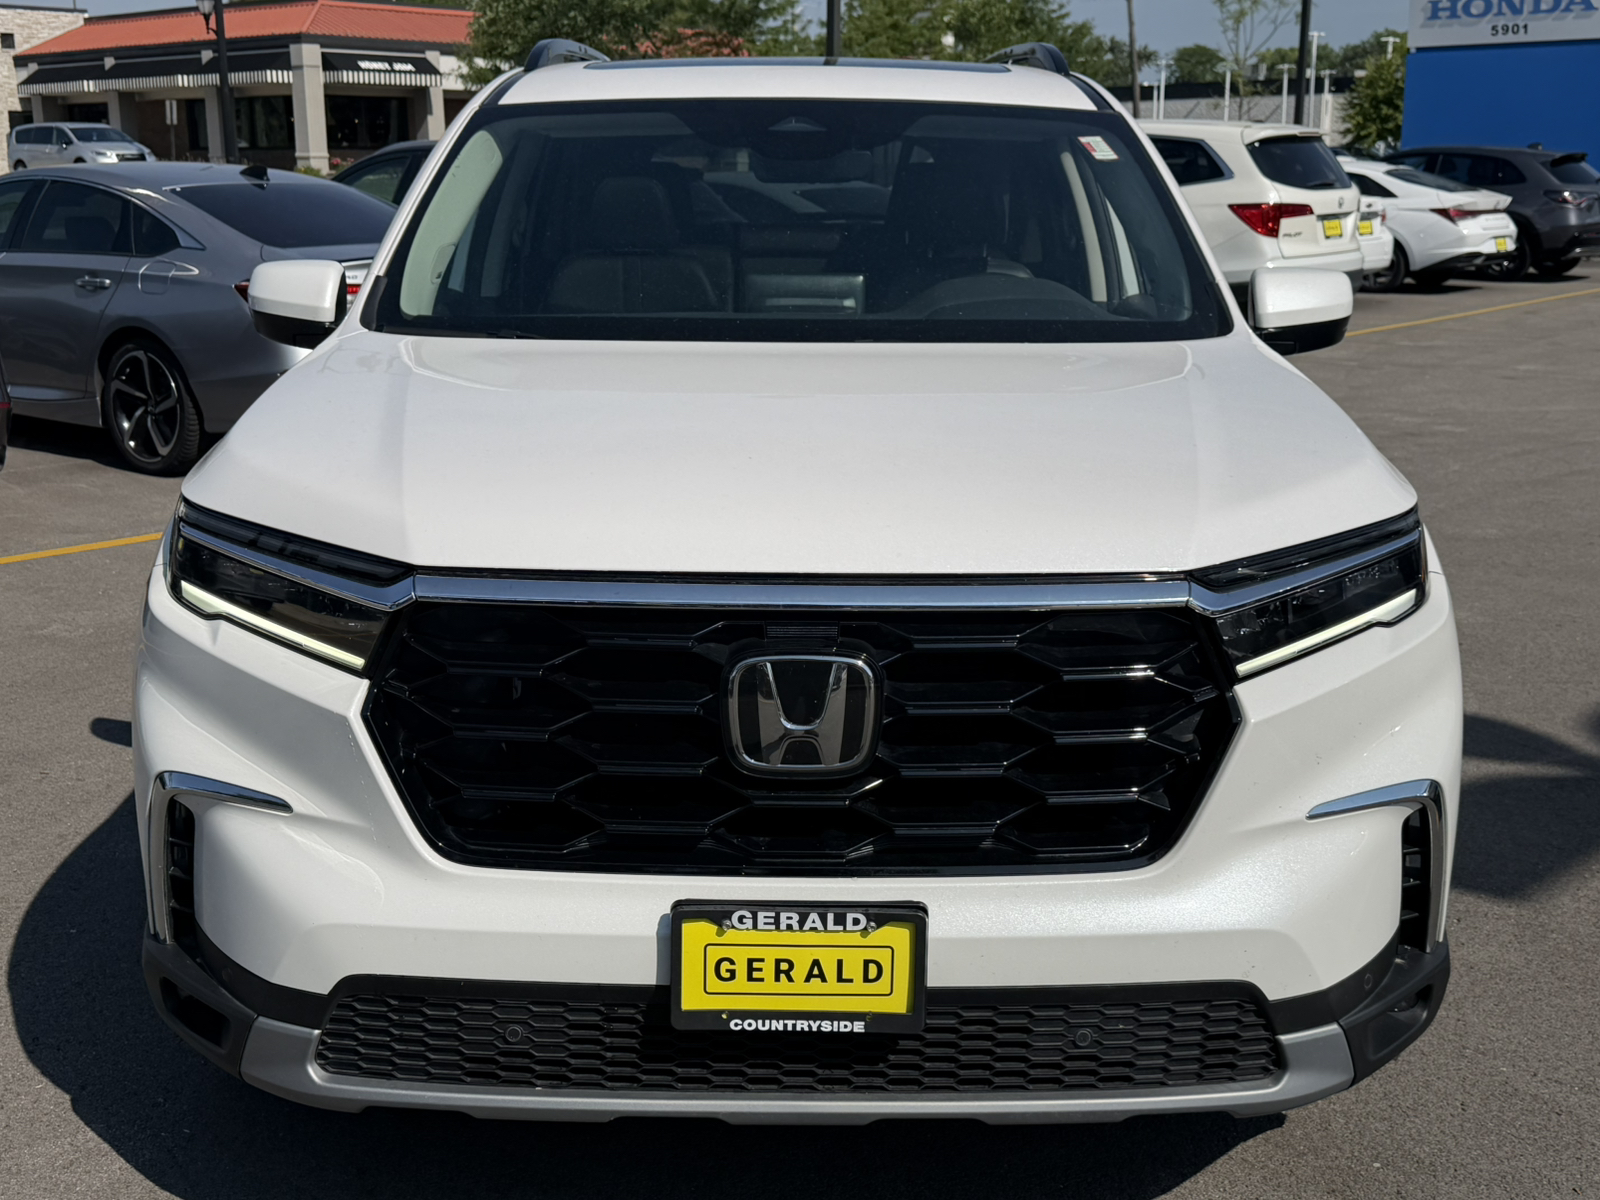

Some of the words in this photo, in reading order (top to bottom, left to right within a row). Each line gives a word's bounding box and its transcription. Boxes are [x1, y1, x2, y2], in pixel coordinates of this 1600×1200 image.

[1427, 0, 1598, 21] HONDA
[1490, 23, 1529, 36] 5901
[731, 909, 868, 931] GERALD
[713, 956, 884, 984] GERALD
[729, 1018, 866, 1033] COUNTRYSIDE
